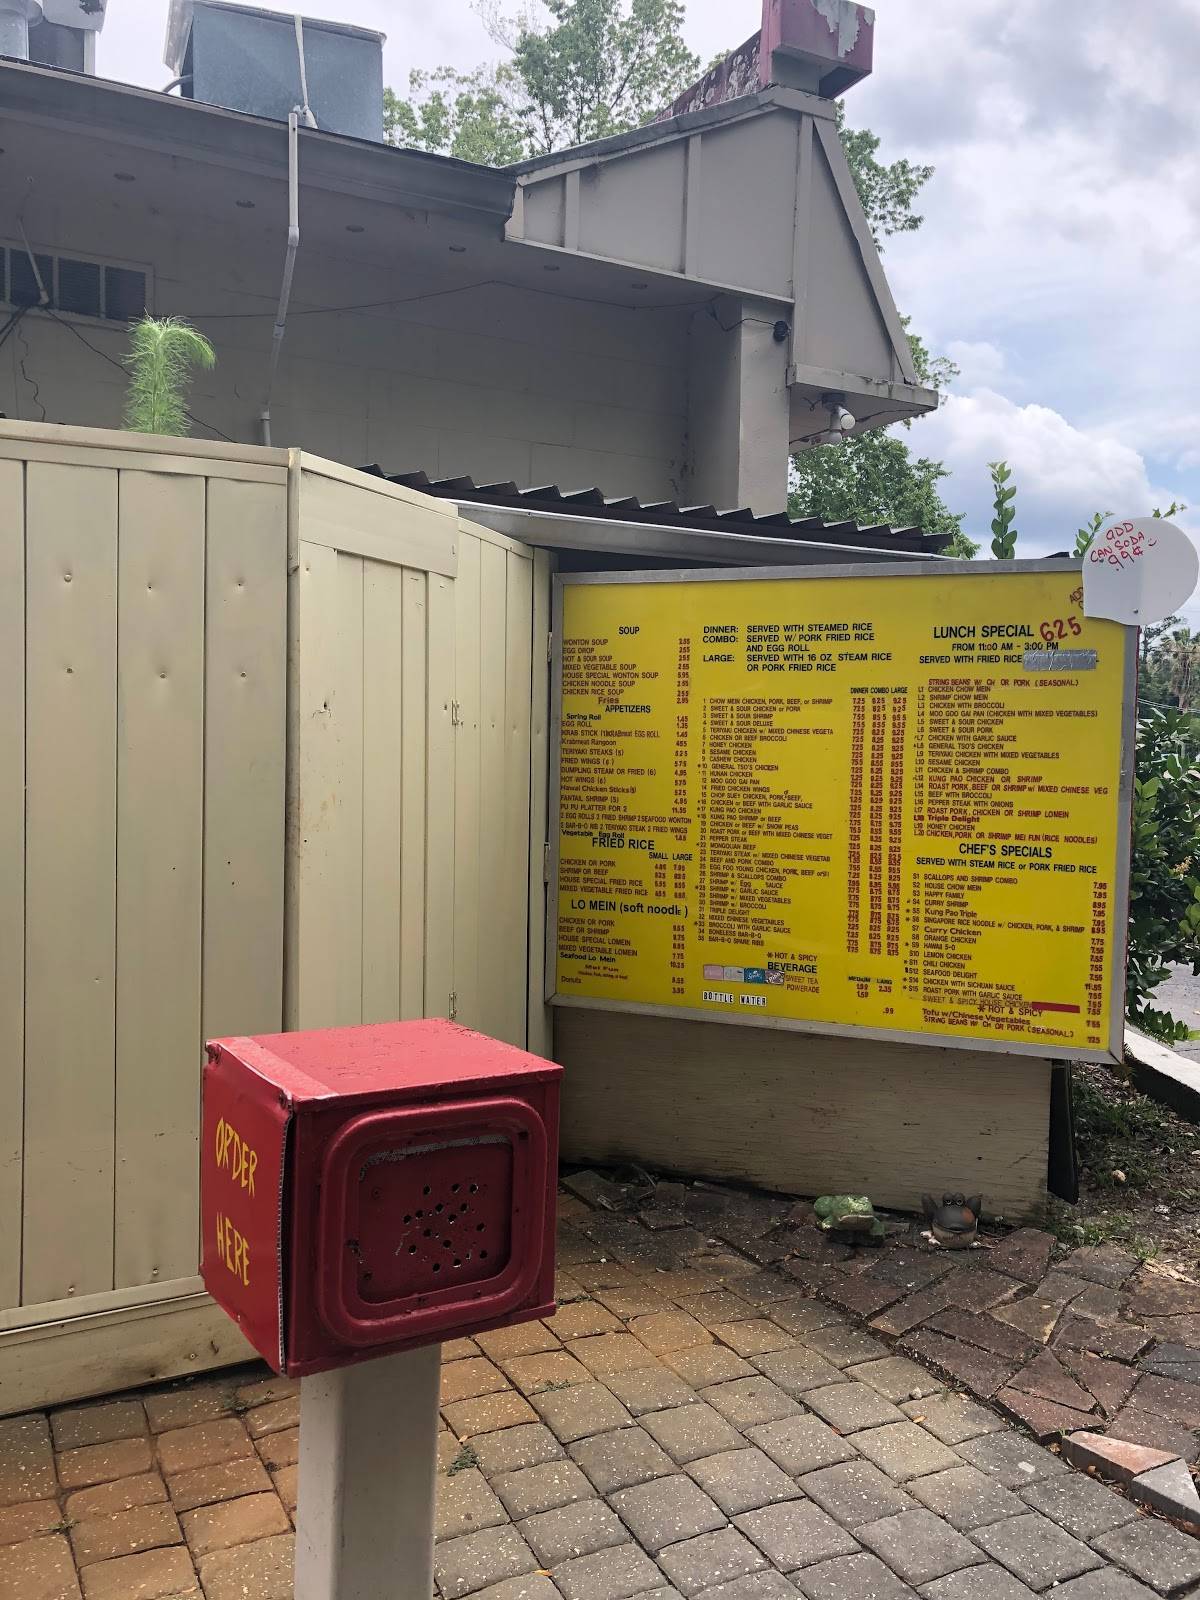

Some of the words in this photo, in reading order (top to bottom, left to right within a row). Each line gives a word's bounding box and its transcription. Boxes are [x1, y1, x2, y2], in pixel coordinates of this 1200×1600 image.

[1091, 546, 1112, 562] CAN
[1115, 532, 1144, 550] SODA
[619, 626, 640, 634] SOUP
[704, 626, 738, 634] DINNER:
[747, 625, 779, 633] SERVED
[808, 624, 848, 632] STEAMED
[853, 623, 872, 631] RICE
[934, 626, 975, 639] LUNCH
[981, 625, 1034, 638] SPECIAL
[1040, 616, 1082, 641] 625
[747, 635, 779, 643] SERVED
[799, 634, 821, 642] PORK
[855, 633, 874, 641] RICE
[746, 644, 763, 652] AND
[767, 644, 784, 652] EGG
[788, 644, 809, 652] ROLL
[1024, 642, 1043, 650] 3:00
[1047, 642, 1058, 650] PM
[747, 654, 779, 662] SERVED
[838, 653, 867, 661] STEAM
[977, 655, 1000, 663] FRIED
[762, 664, 785, 672] PORK
[789, 664, 813, 672] FRIED
[817, 664, 836, 672] RICE
[605, 705, 651, 713] APPETIZERS
[592, 838, 624, 848] FRIED
[629, 839, 654, 850] RICE
[959, 843, 996, 855] CHEF'S
[1001, 845, 1052, 858] SPECIALS
[916, 857, 945, 865] SERVED
[948, 859, 966, 867] WITH
[970, 860, 995, 869] STEAM
[998, 861, 1015, 869] RICE
[1030, 863, 1050, 871] PORK
[1054, 864, 1076, 872] FRIED
[1079, 865, 1096, 873] RICE
[571, 900, 585, 910] LO
[590, 900, 615, 911] MEIN
[620, 902, 643, 914] (soft
[925, 908, 943, 917] Kung
[925, 926, 946, 935] Curry
[950, 928, 981, 936] Chicken
[560, 952, 586, 960] Seafood
[600, 955, 615, 963] Mein
[768, 962, 817, 973] BEVERAGE
[923, 969, 950, 977] SEAFOOD
[953, 971, 977, 979] DELIGHT
[808, 976, 818, 984] TEA
[787, 984, 819, 993] POWERADE
[703, 992, 733, 1002] BOTTLE
[741, 995, 766, 1005] WATER
[989, 1005, 1004, 1014] HOT
[1019, 1009, 1043, 1017] SPICY
[985, 1014, 1030, 1025] Vegetables
[215, 1116, 257, 1198] ORDER
[216, 1212, 250, 1286] HERE
